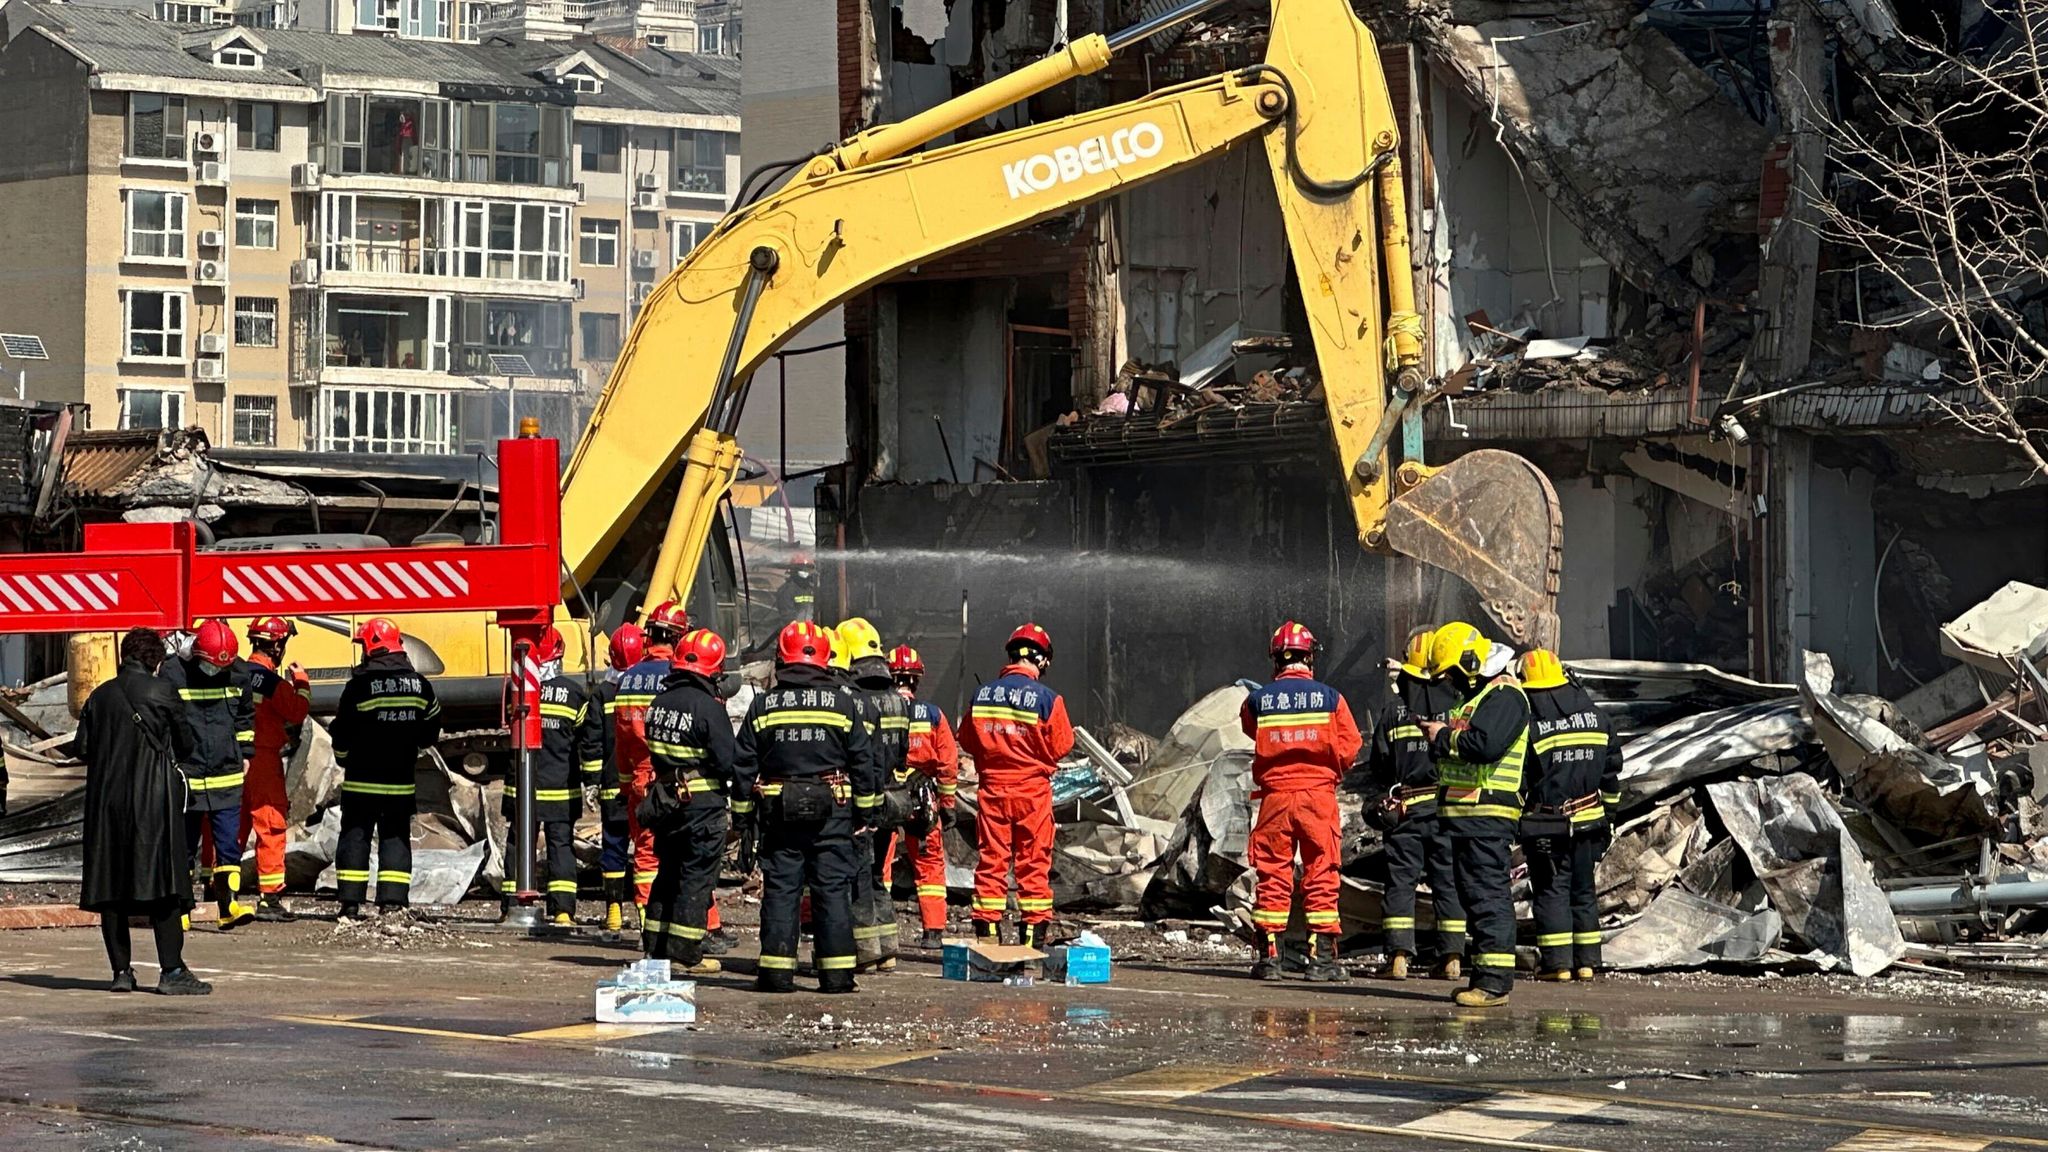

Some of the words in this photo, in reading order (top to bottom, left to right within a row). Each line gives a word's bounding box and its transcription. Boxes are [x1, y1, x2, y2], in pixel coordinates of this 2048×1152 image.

[1001, 121, 1164, 200] KOBELCO
[370, 678, 422, 695] 应急消防
[541, 685, 569, 703] 消防
[765, 689, 836, 710] 应急消防
[977, 685, 1038, 708] 应急消防
[1261, 691, 1324, 711] 应急消防
[1537, 712, 1598, 735] 应急消防
[775, 728, 826, 742] 河北廊坊
[1269, 728, 1318, 743] 河北廊坊
[1552, 748, 1595, 763] 河北廊坊
